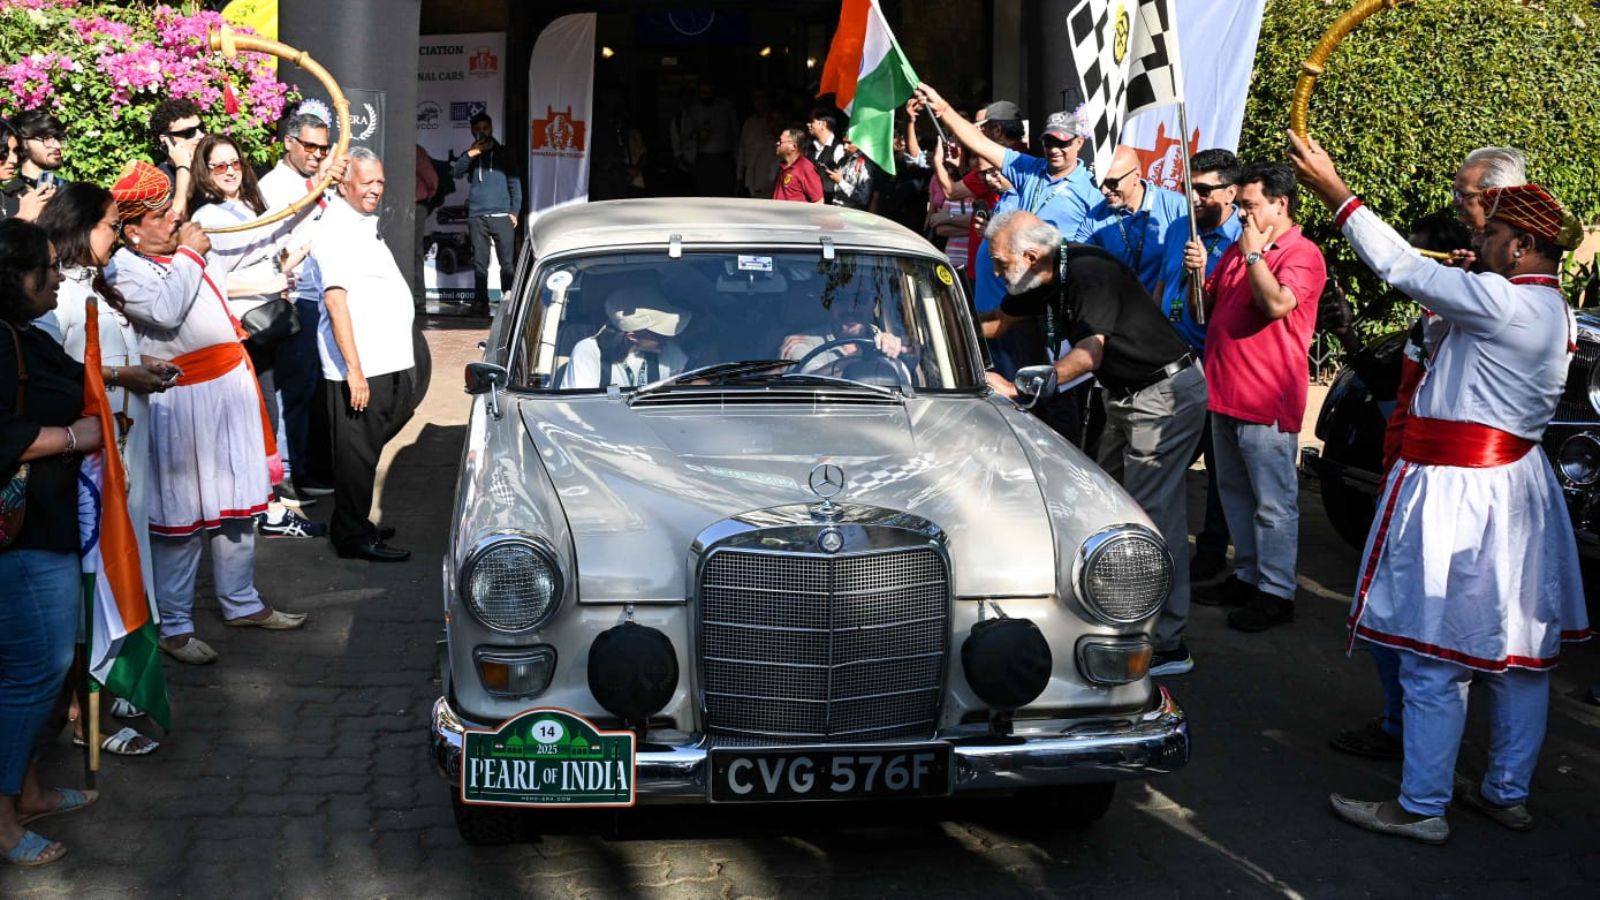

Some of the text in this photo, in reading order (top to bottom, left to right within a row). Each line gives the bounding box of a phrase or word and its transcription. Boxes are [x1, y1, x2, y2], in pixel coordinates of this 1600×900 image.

[439, 71, 465, 81] CARS
[540, 725, 555, 737] 14
[536, 743, 558, 755] 2025
[469, 757, 629, 791] PEARL OF INDIA
[727, 753, 935, 794] CVG 576F
